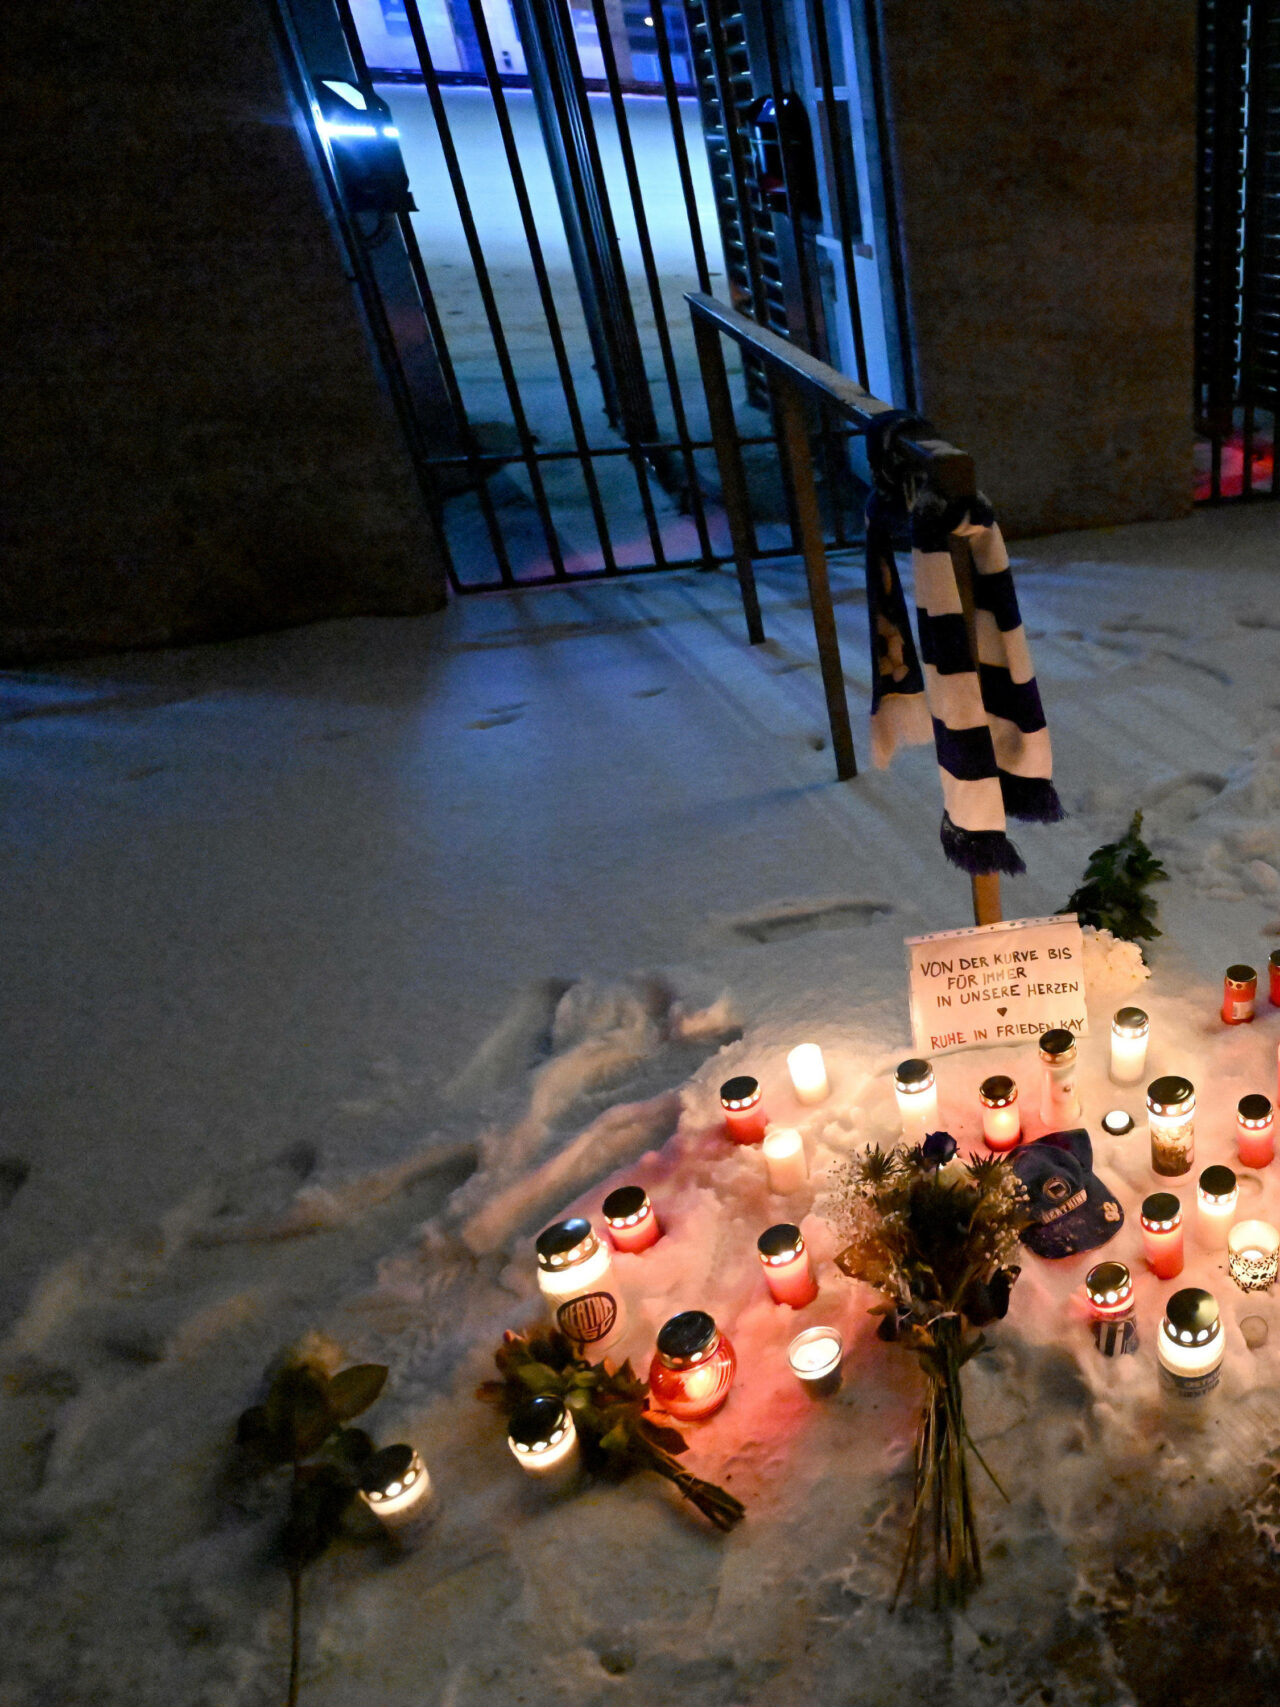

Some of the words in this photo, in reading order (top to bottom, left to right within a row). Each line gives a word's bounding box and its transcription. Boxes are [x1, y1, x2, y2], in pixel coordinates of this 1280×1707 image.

[920, 960, 953, 978] VON
[959, 956, 990, 970] DER
[994, 950, 1039, 964] KURVE
[1047, 947, 1073, 960] BIS
[947, 974, 978, 990] FÜR
[983, 967, 1027, 985] IMMER
[936, 995, 952, 1008] IN
[960, 984, 1021, 1004] UNSERE
[1027, 981, 1079, 998] HERZEN
[930, 1031, 967, 1050] RUHE
[973, 1028, 988, 1041] IN
[996, 1022, 1055, 1038] FRIEDEN
[1060, 1018, 1085, 1031] KAY
